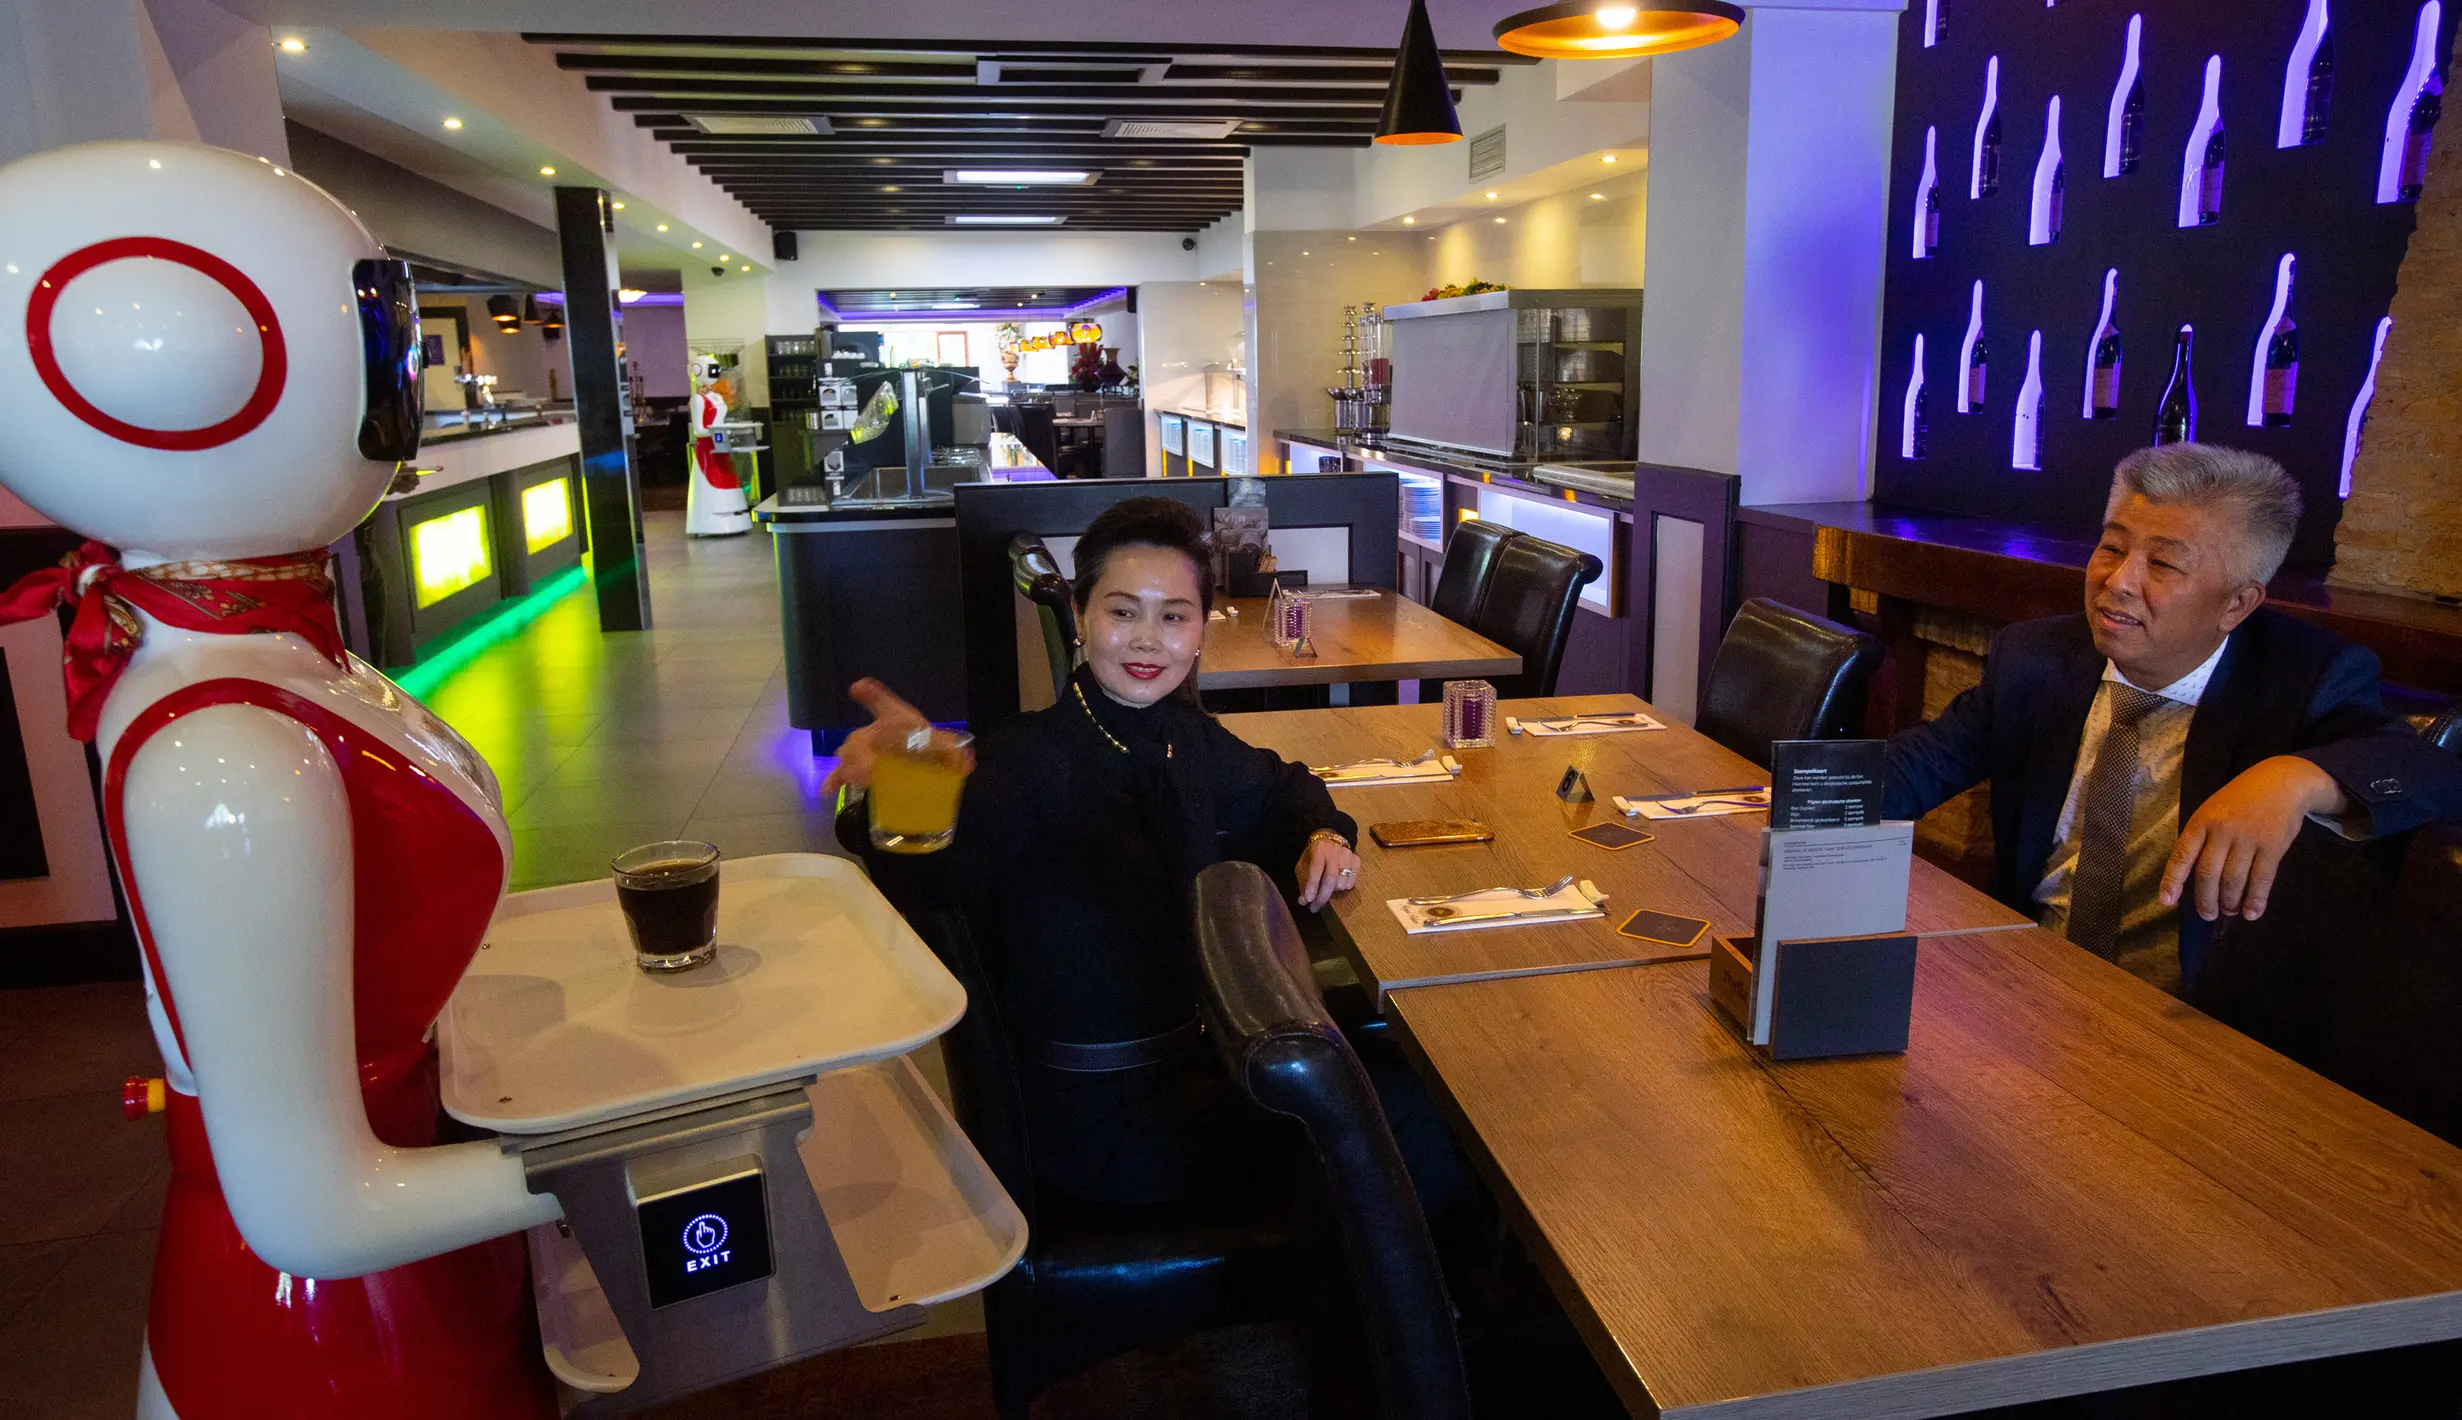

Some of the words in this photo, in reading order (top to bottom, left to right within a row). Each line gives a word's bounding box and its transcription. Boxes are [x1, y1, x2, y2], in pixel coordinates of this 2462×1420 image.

[1215, 510, 1246, 525] Wijn
[1561, 769, 1576, 793] 6
[686, 1250, 731, 1272] EXIT
